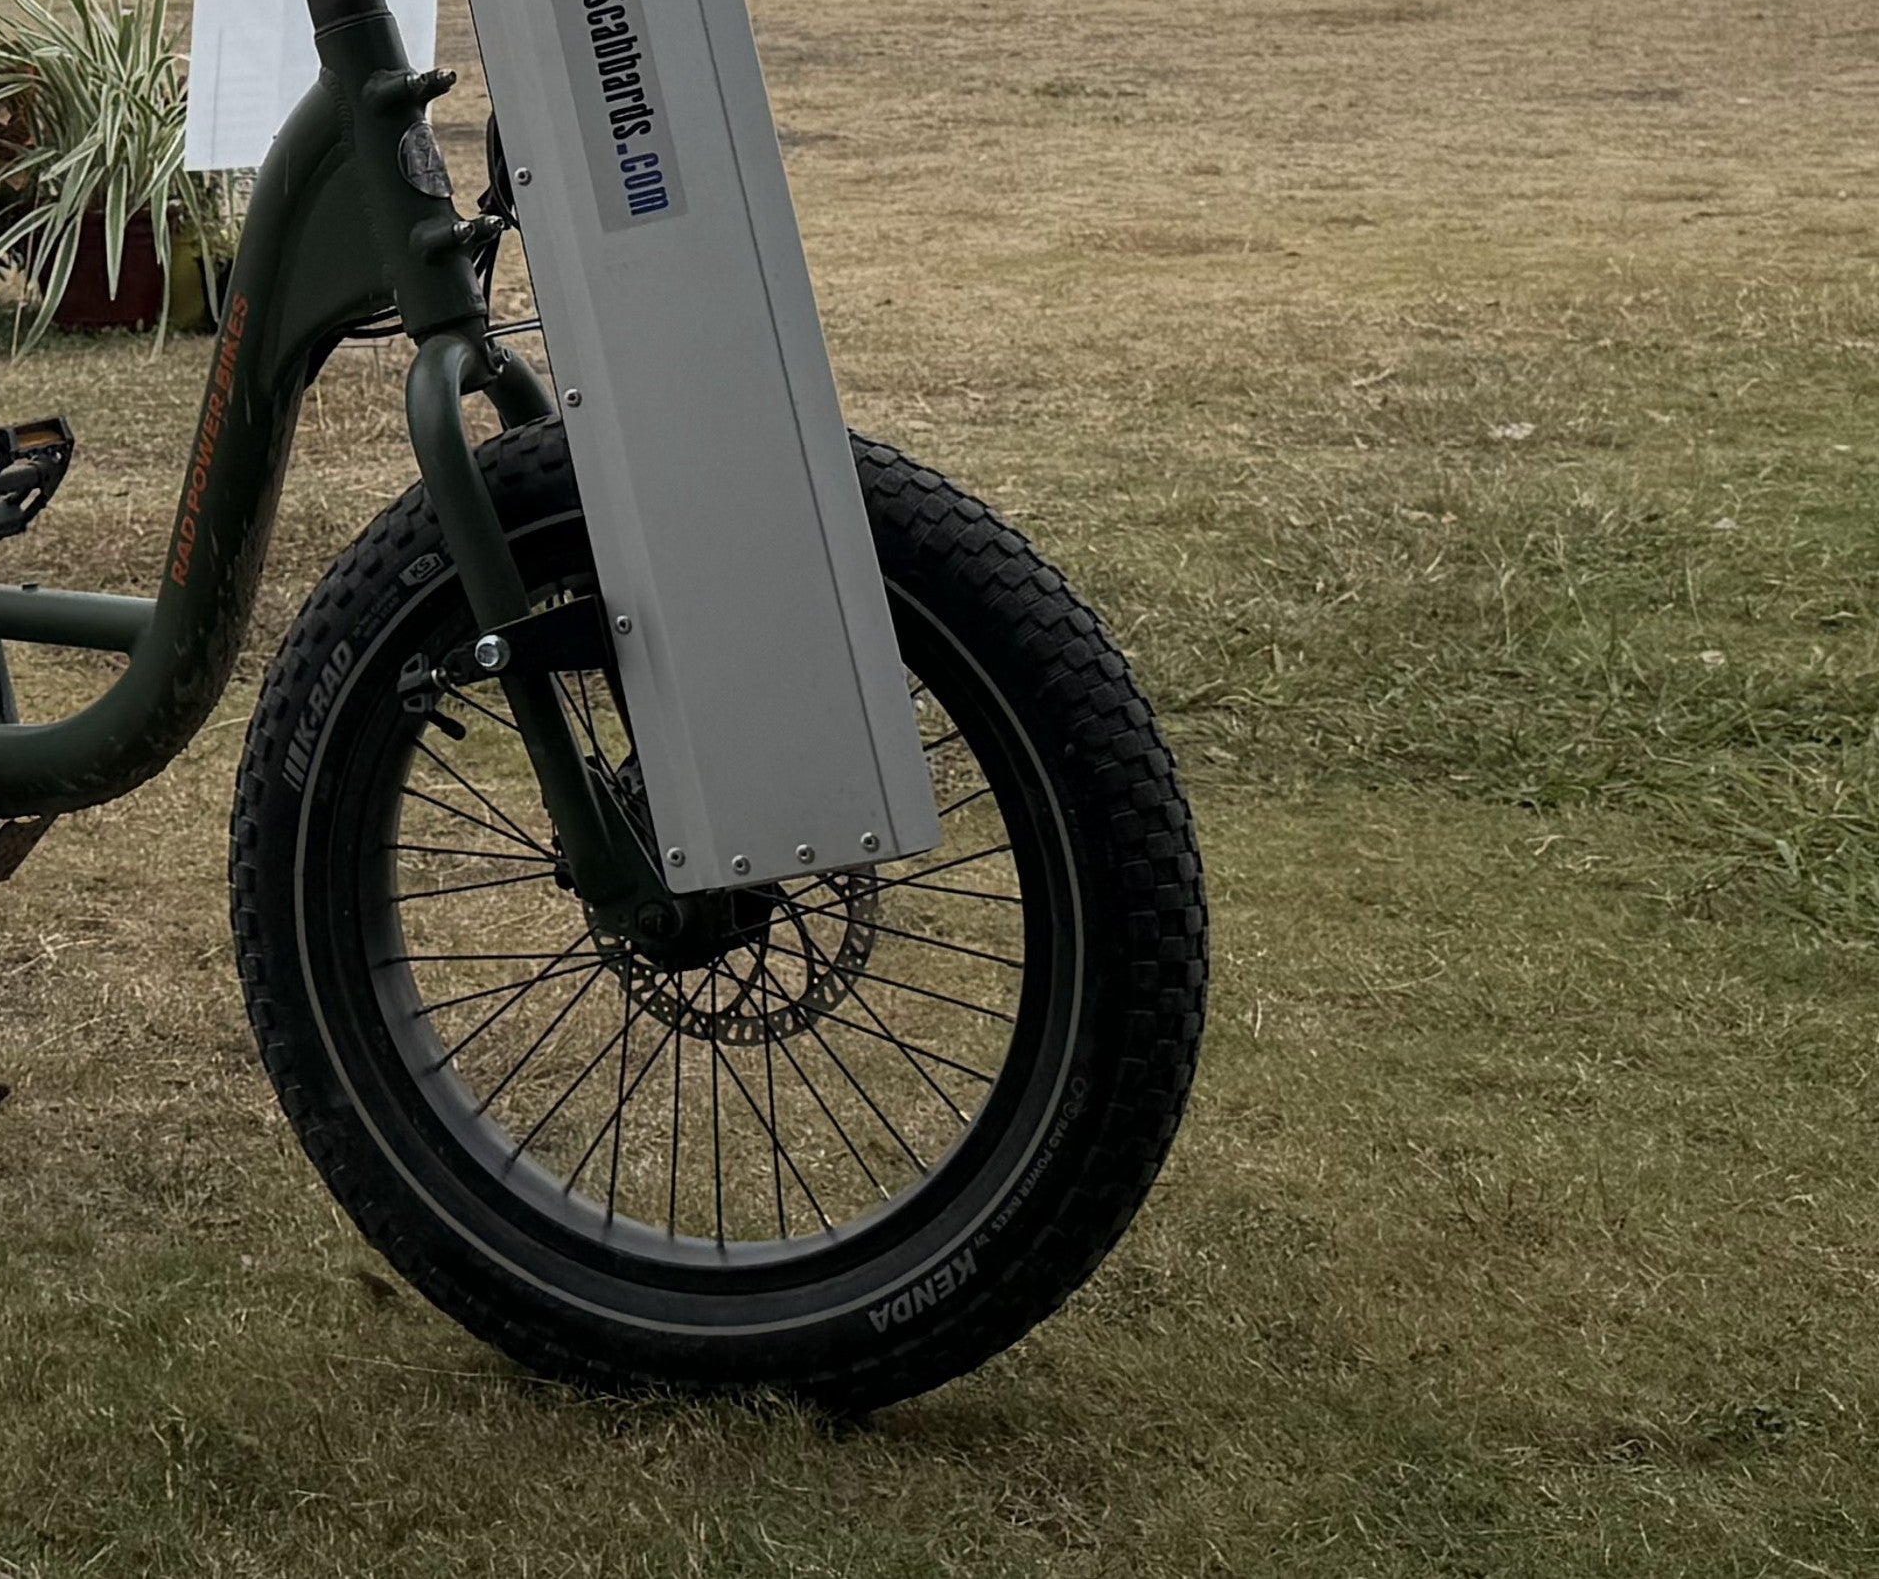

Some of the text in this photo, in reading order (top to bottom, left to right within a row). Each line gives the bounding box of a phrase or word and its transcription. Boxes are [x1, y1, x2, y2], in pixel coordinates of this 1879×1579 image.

[172, 292, 249, 588] RAD POWER BIKES
[294, 639, 354, 752] K-RAD
[868, 1248, 978, 1334] KENDA
